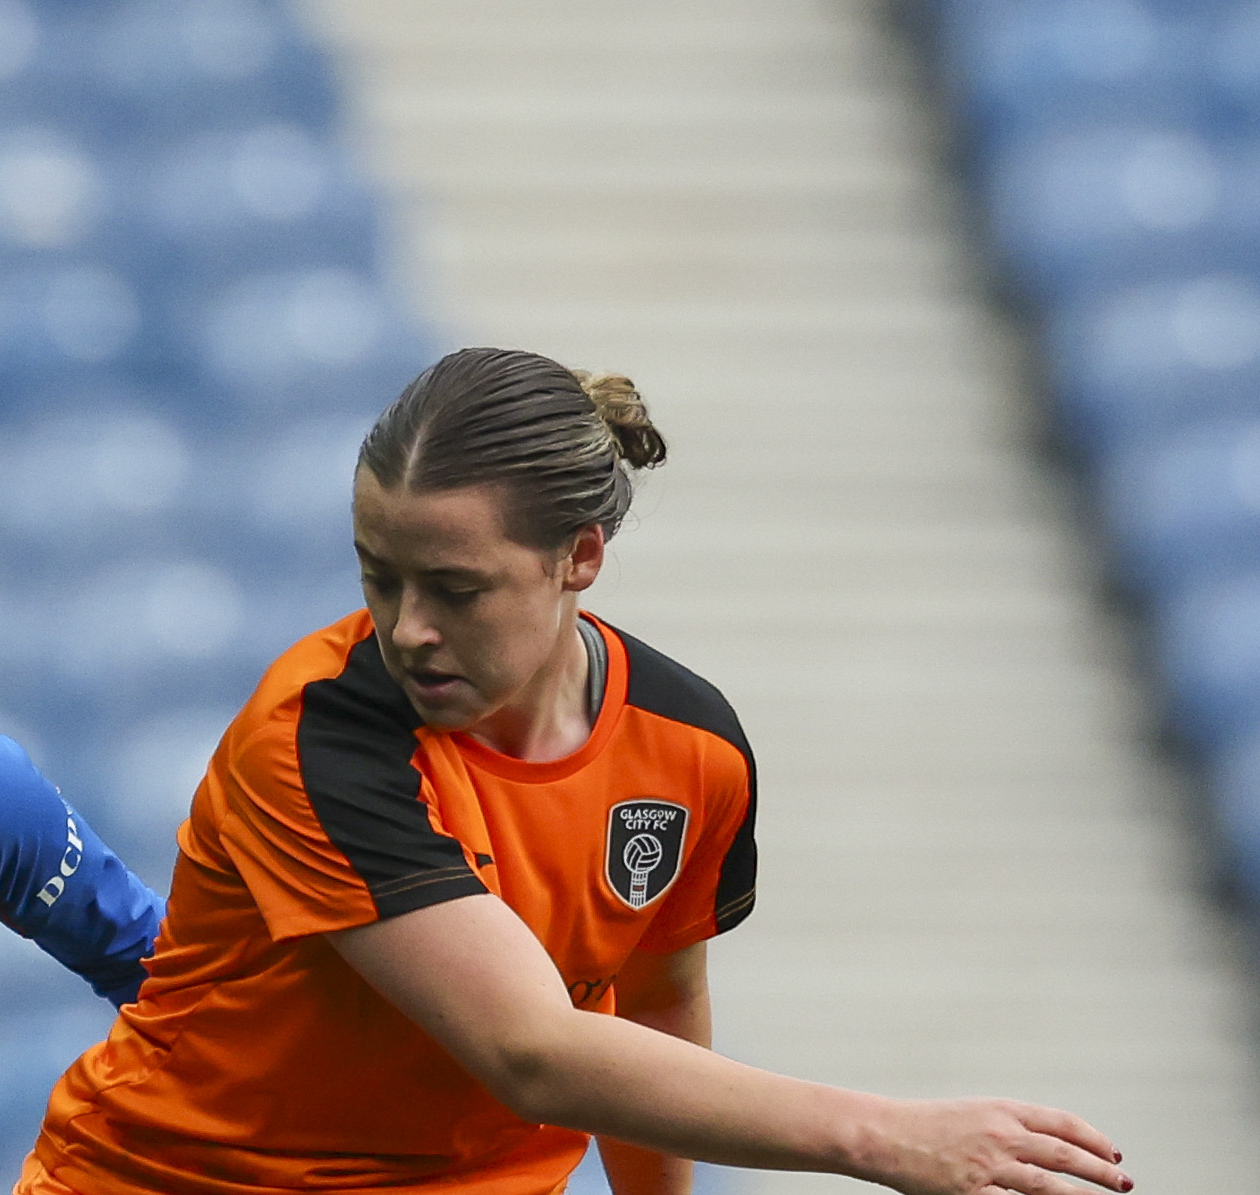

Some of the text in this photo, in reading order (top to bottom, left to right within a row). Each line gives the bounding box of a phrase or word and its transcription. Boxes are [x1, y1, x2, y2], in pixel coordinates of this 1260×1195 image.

[620, 808, 677, 821] GLASGOW
[625, 819, 668, 831] CITY FC
